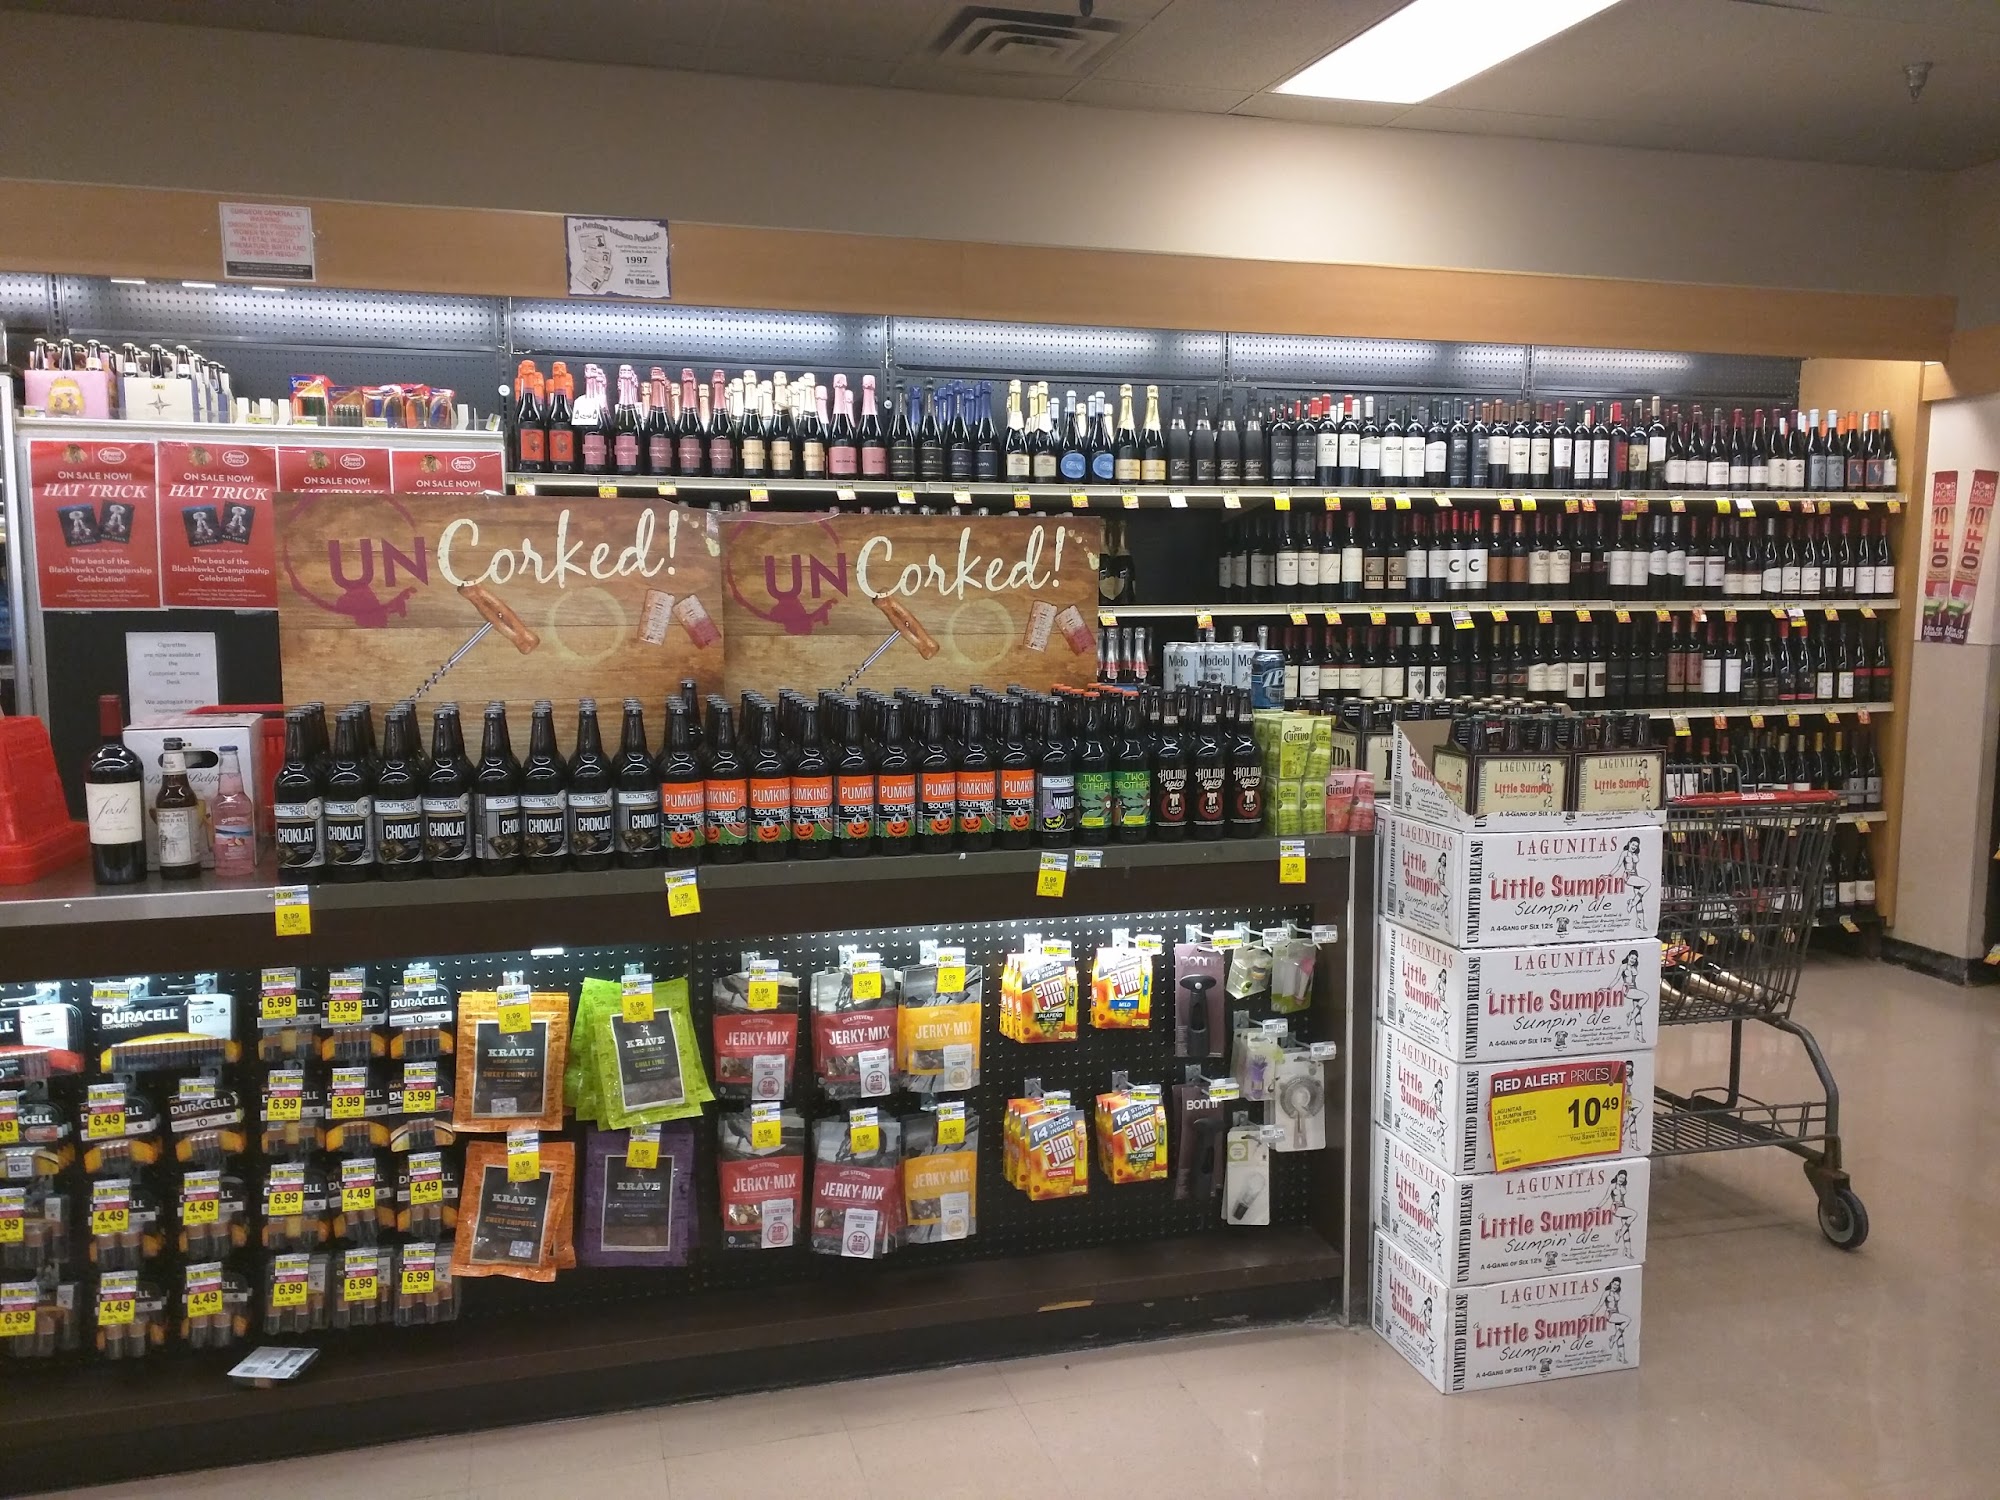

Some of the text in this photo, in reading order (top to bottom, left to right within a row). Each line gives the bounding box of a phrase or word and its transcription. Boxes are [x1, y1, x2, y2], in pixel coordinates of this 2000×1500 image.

[58, 472, 132, 481] ON SALE NOW!
[184, 473, 254, 483] ON SALE NOW!
[43, 484, 148, 498] HAT TRICK
[168, 484, 269, 500] HAT TRICK
[328, 508, 679, 590] UN Corked!
[1932, 528, 1950, 568] OFF
[1961, 528, 1983, 569] OFF
[70, 557, 85, 565] The
[87, 557, 105, 565] best
[764, 525, 1065, 600] UN Corked!
[96, 567, 152, 575] Championship
[172, 565, 269, 575] Blackhawks Championship
[77, 575, 126, 583] Celebration!
[198, 574, 245, 582] Celebration!
[1284, 731, 1309, 743] Cuervo
[1083, 774, 1102, 782] TWO
[1125, 772, 1144, 780] TWO
[1495, 783, 1518, 794] Little
[429, 821, 465, 837] CHOKLAT
[528, 817, 562, 833] CHOKLAT
[578, 815, 611, 831] CHOKLAT
[278, 827, 314, 843] CHOKLAT
[328, 825, 364, 841] CHOKLAT
[385, 823, 420, 839] CHOKLAT
[1400, 823, 1452, 851] LAGUNITAS
[1517, 836, 1618, 855] LAGUNITAS
[1402, 850, 1426, 874] Little
[1467, 840, 1483, 944] UNLIMITED RELEASE
[1490, 876, 1545, 901] Little
[1514, 950, 1616, 971] LAGUNITAS
[267, 997, 291, 1009] 6.99
[334, 1001, 357, 1012] 3.99
[391, 995, 447, 1009] DURACELL
[1465, 956, 1481, 1059] UNLIMITED RELEASE
[1488, 991, 1544, 1016] Little
[102, 1008, 178, 1025] DURACELL
[625, 1036, 665, 1049] KRAVE
[488, 1048, 535, 1057] KRAVE
[1494, 1078, 1521, 1093] RED
[1524, 1072, 1566, 1088] ALERT
[272, 1099, 297, 1109] 6.99
[336, 1097, 360, 1108] 3.99
[408, 1091, 431, 1102] 3.99
[170, 1098, 232, 1115] DURACELL
[93, 1114, 119, 1126] 6.49
[1033, 1127, 1048, 1142] 14
[415, 1181, 438, 1193] 4.49
[1506, 1170, 1605, 1195] LAGUNITAS
[274, 1192, 298, 1204] 6.99
[189, 1202, 214, 1213] 4.49
[98, 1211, 124, 1222] 4.49
[1457, 1183, 1473, 1283] UNLIMITED RELEASE
[1480, 1213, 1534, 1240] Little
[1501, 1278, 1599, 1304] LAGUNITAS
[104, 1302, 130, 1313] 4.49
[4, 1313, 30, 1323] 6.99
[1453, 1293, 1468, 1392] UNLIMITED RELEASE
[1476, 1322, 1529, 1349] Little
